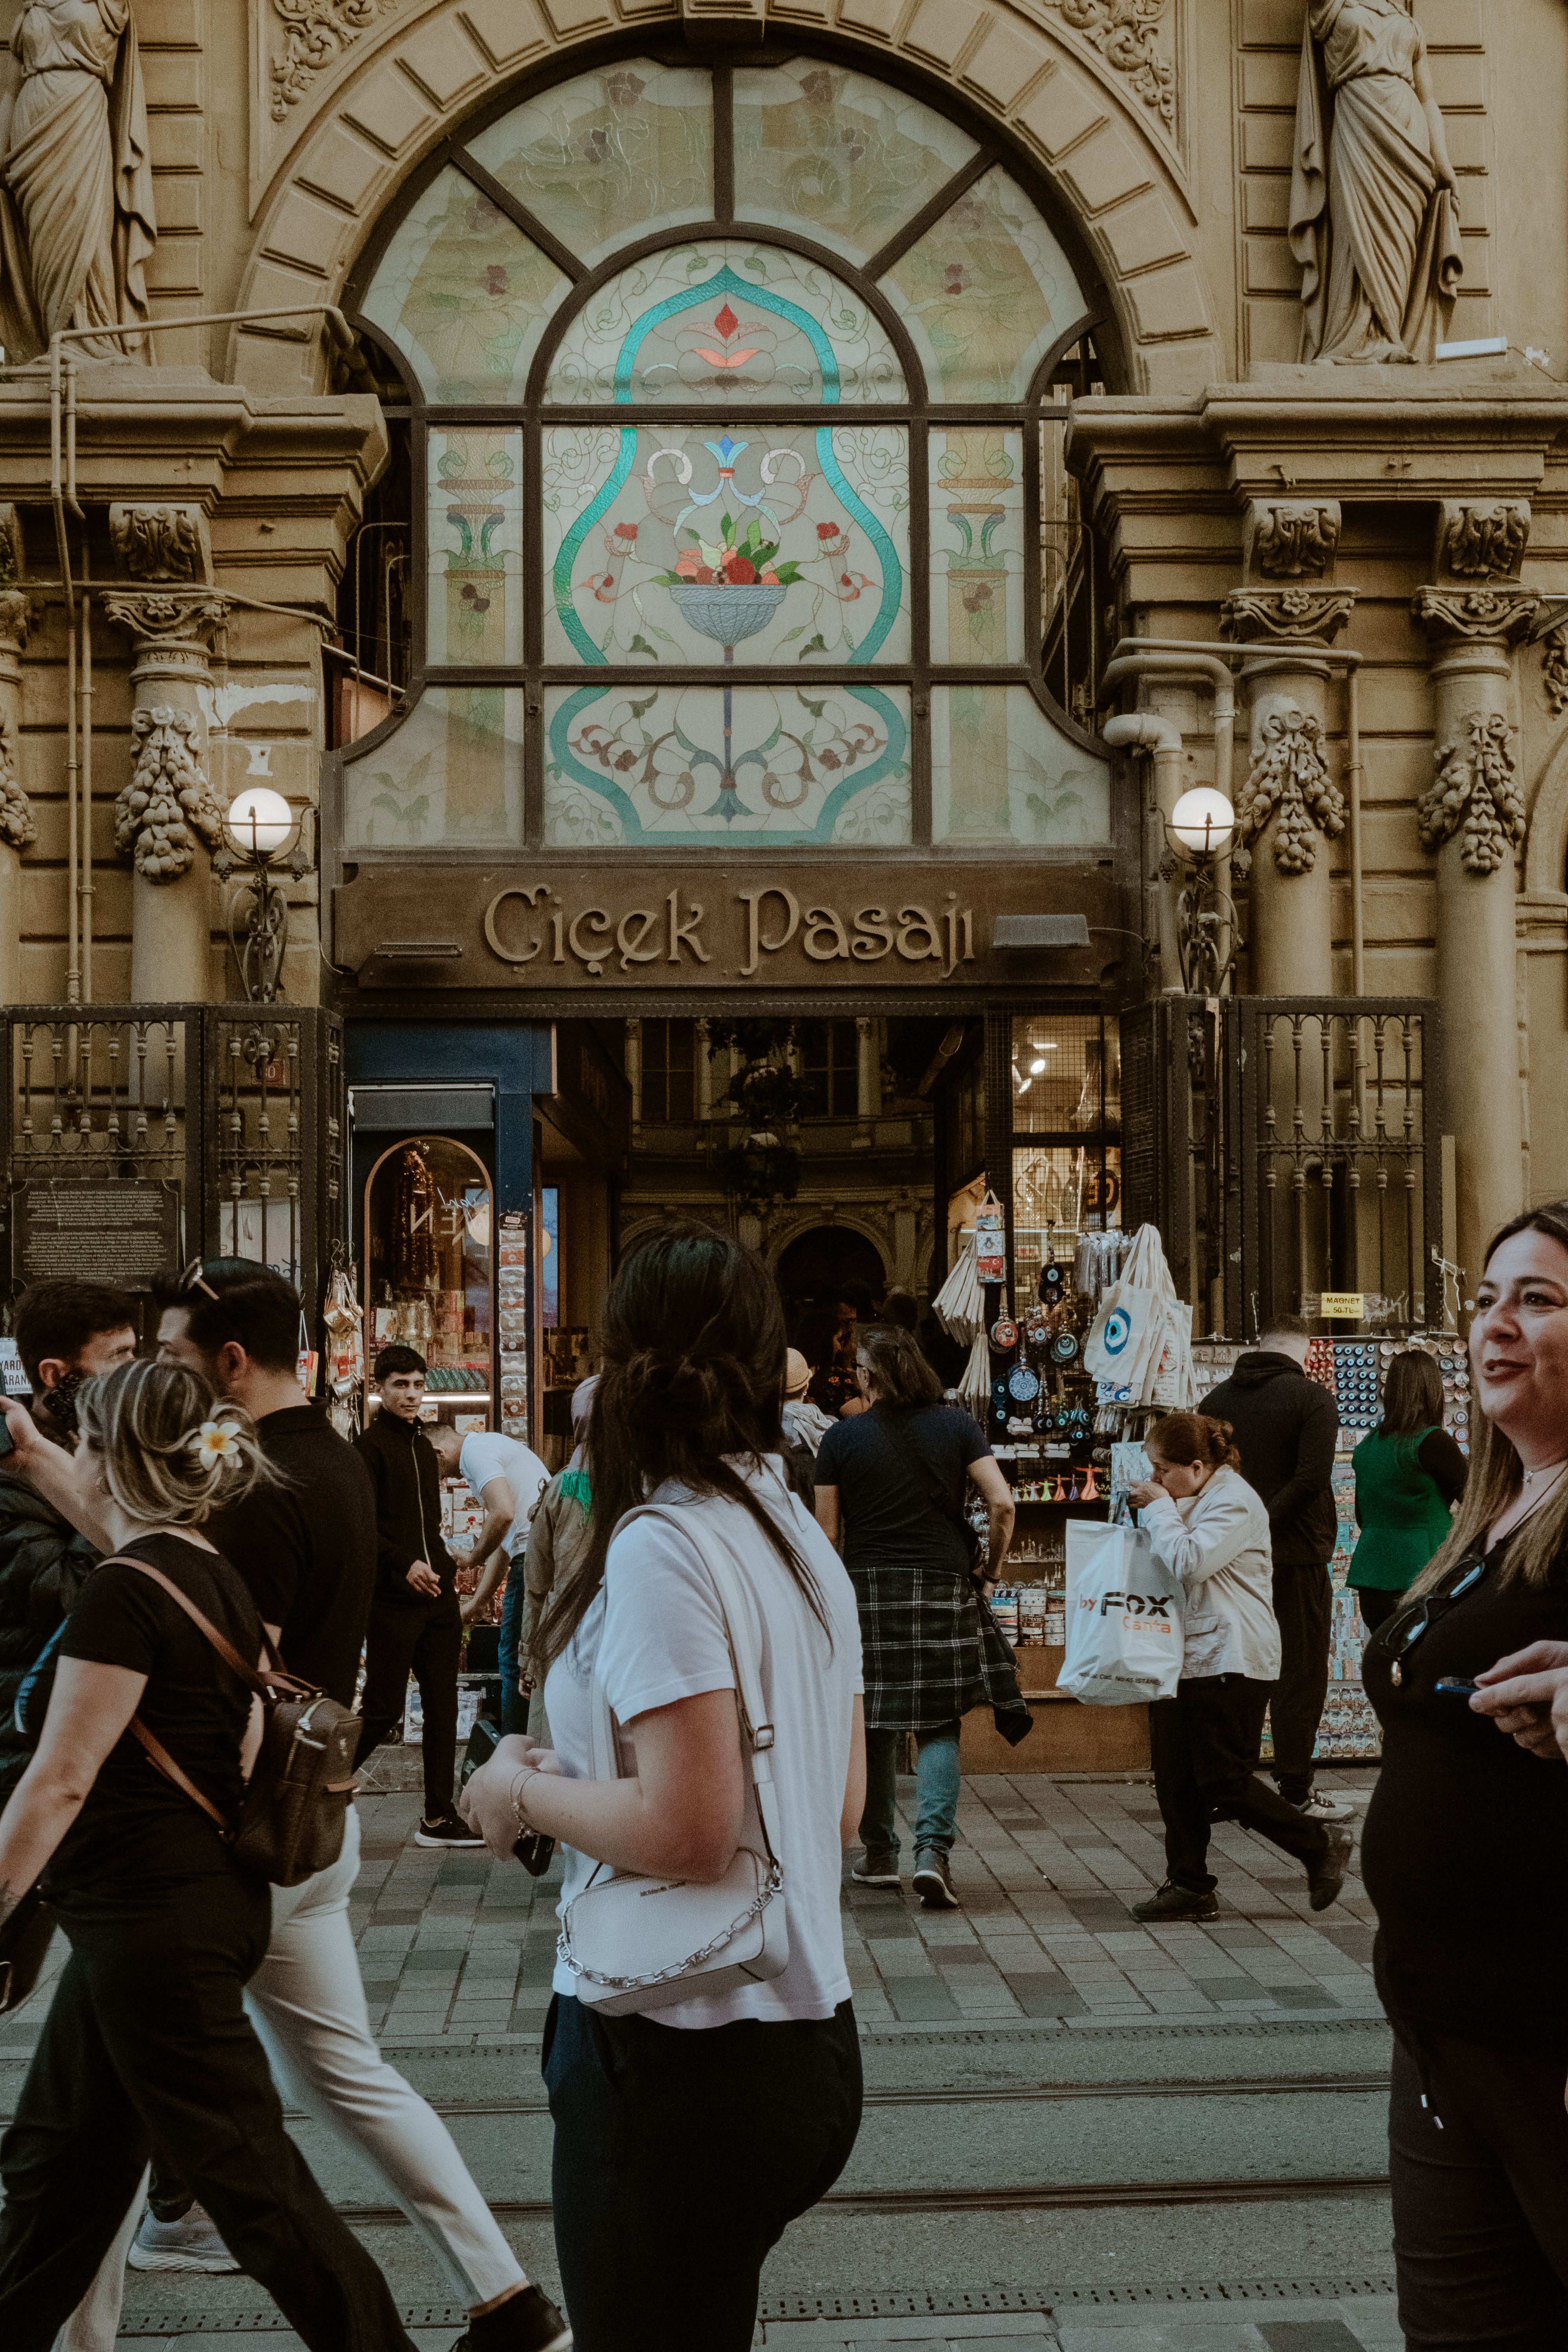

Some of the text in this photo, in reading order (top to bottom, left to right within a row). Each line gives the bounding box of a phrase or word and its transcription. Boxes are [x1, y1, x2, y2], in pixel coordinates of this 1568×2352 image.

[739, 887, 975, 978] Pasajı
[0, 1360, 24, 1370] YARD
[4, 1375, 30, 1385] ARAN
[1080, 1591, 1170, 1618] by FOX
